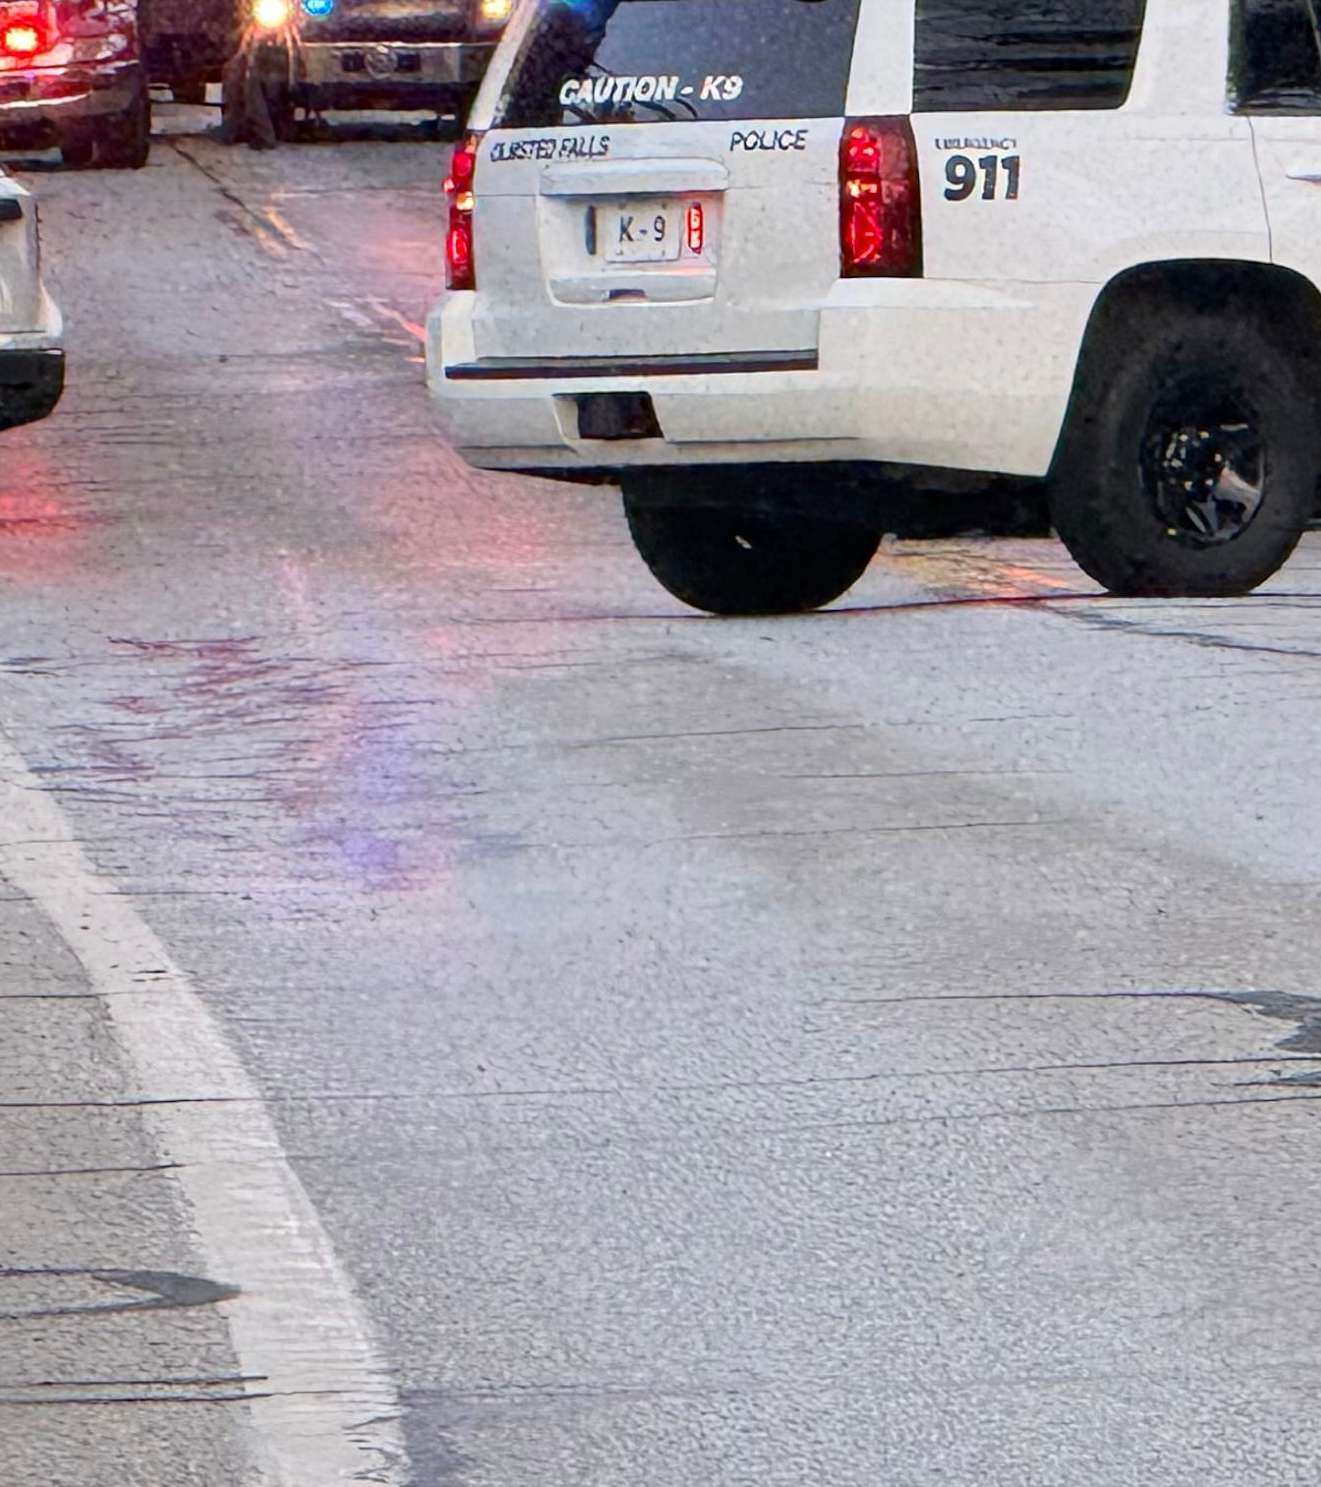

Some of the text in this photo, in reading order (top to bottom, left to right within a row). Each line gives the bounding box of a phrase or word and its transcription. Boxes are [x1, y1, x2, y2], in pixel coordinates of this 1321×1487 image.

[559, 75, 679, 105] CAUTION
[699, 75, 744, 101] K9
[558, 135, 611, 159] FALLS
[729, 129, 809, 152] POLICE
[943, 154, 1021, 201] 911
